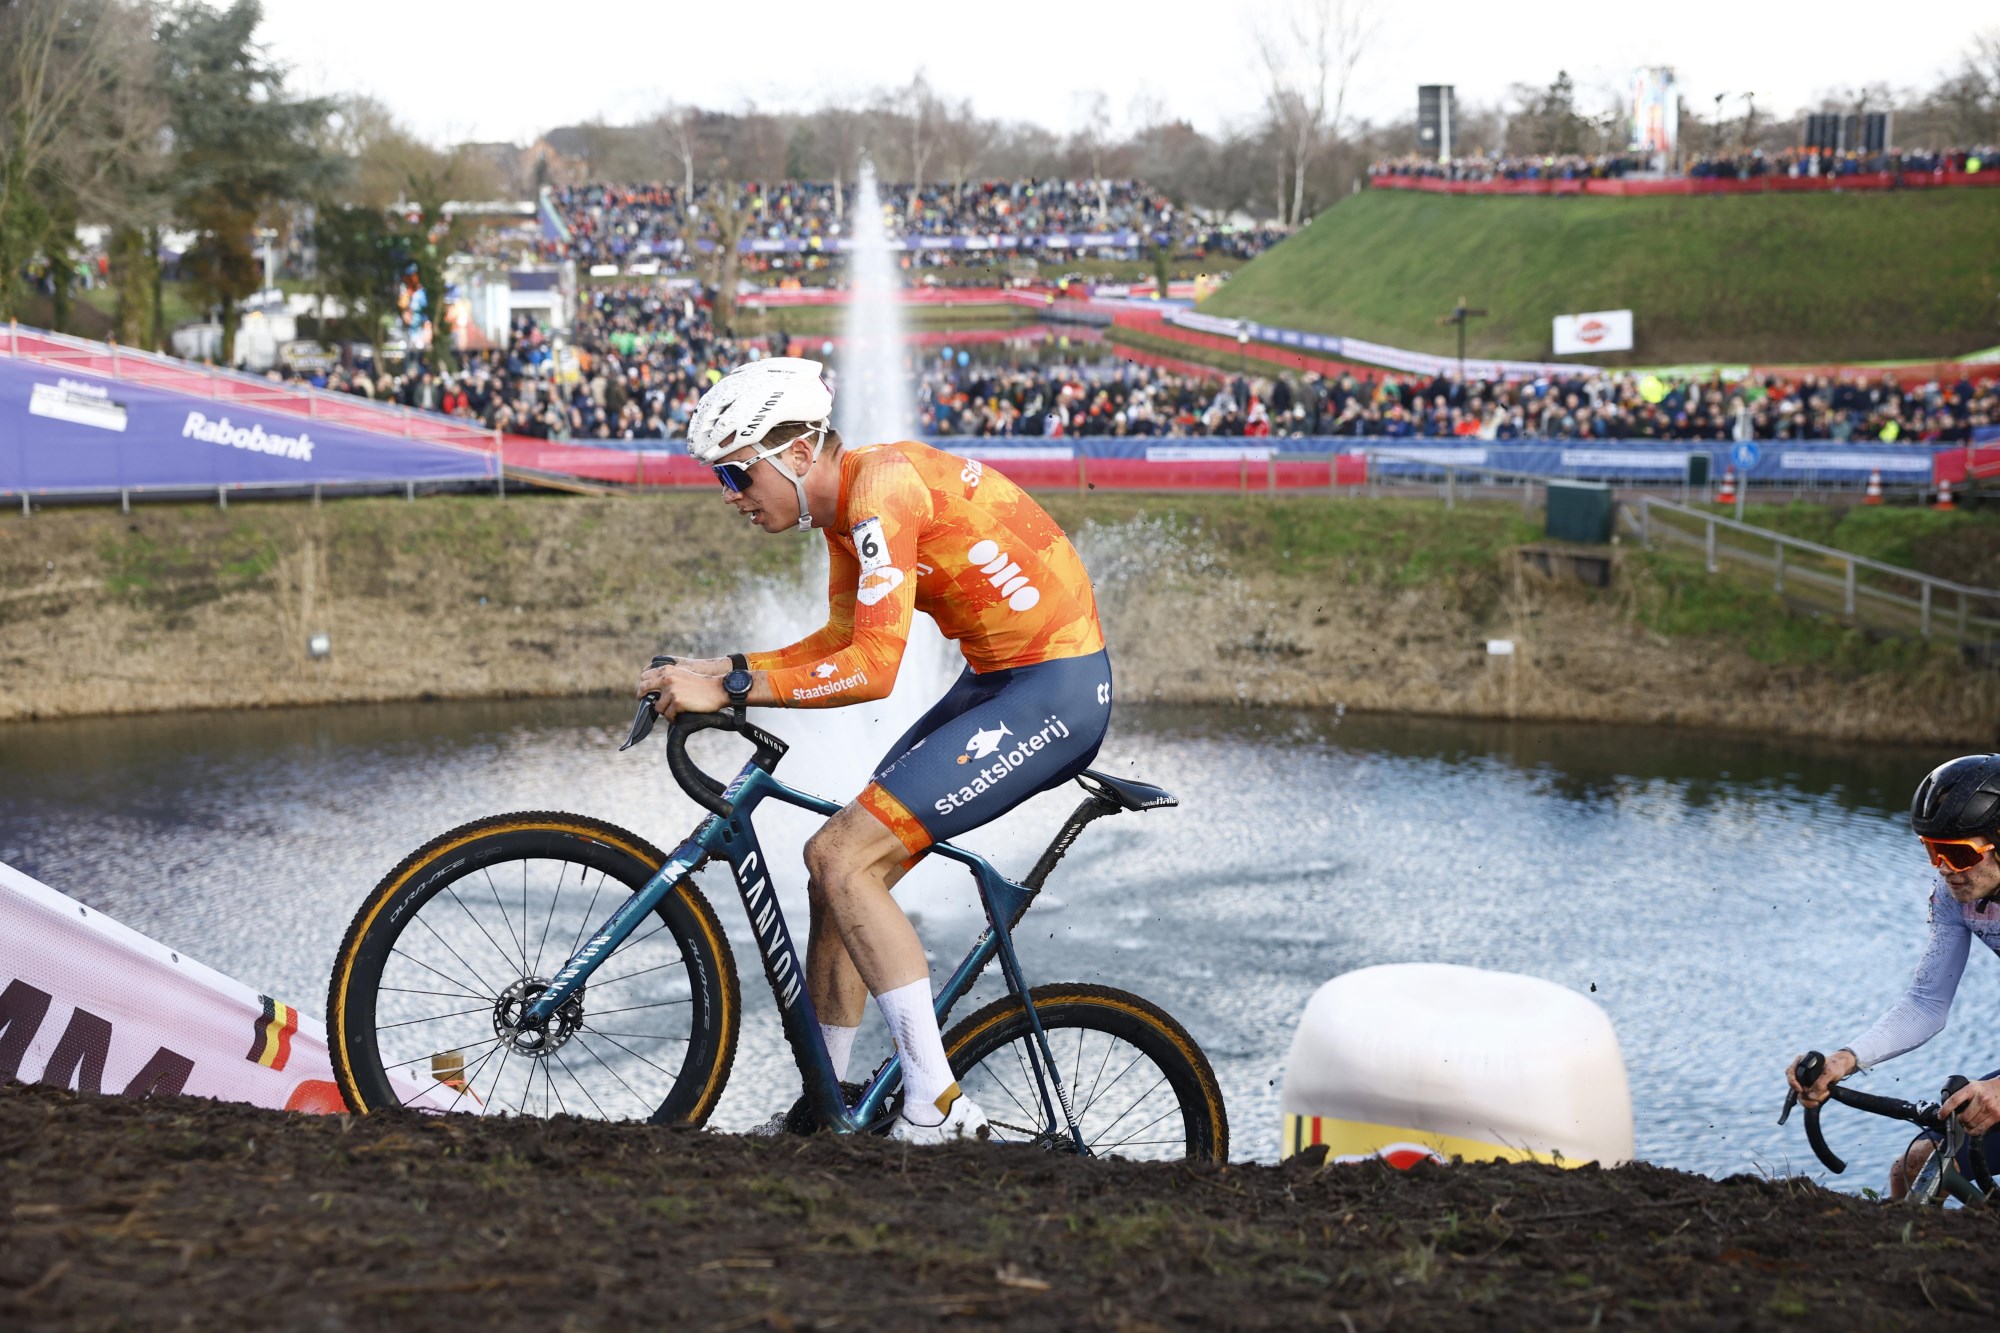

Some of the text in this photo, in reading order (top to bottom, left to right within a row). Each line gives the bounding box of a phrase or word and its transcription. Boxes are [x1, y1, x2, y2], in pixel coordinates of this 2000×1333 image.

[182, 411, 315, 462] Rabobank
[740, 392, 784, 437] CANYON
[861, 532, 879, 559] 6
[792, 667, 868, 700] Staatsloterij
[753, 729, 783, 754] CANYON
[934, 714, 1070, 815] Staatsloterij
[1055, 823, 1081, 853] CANYON
[389, 858, 466, 924] DURA-ACE
[737, 850, 802, 1011] CANYON
[539, 935, 612, 1001] CANYON
[688, 938, 711, 1031] DURA-ACE
[1056, 1082, 1077, 1128] SHIMANO
